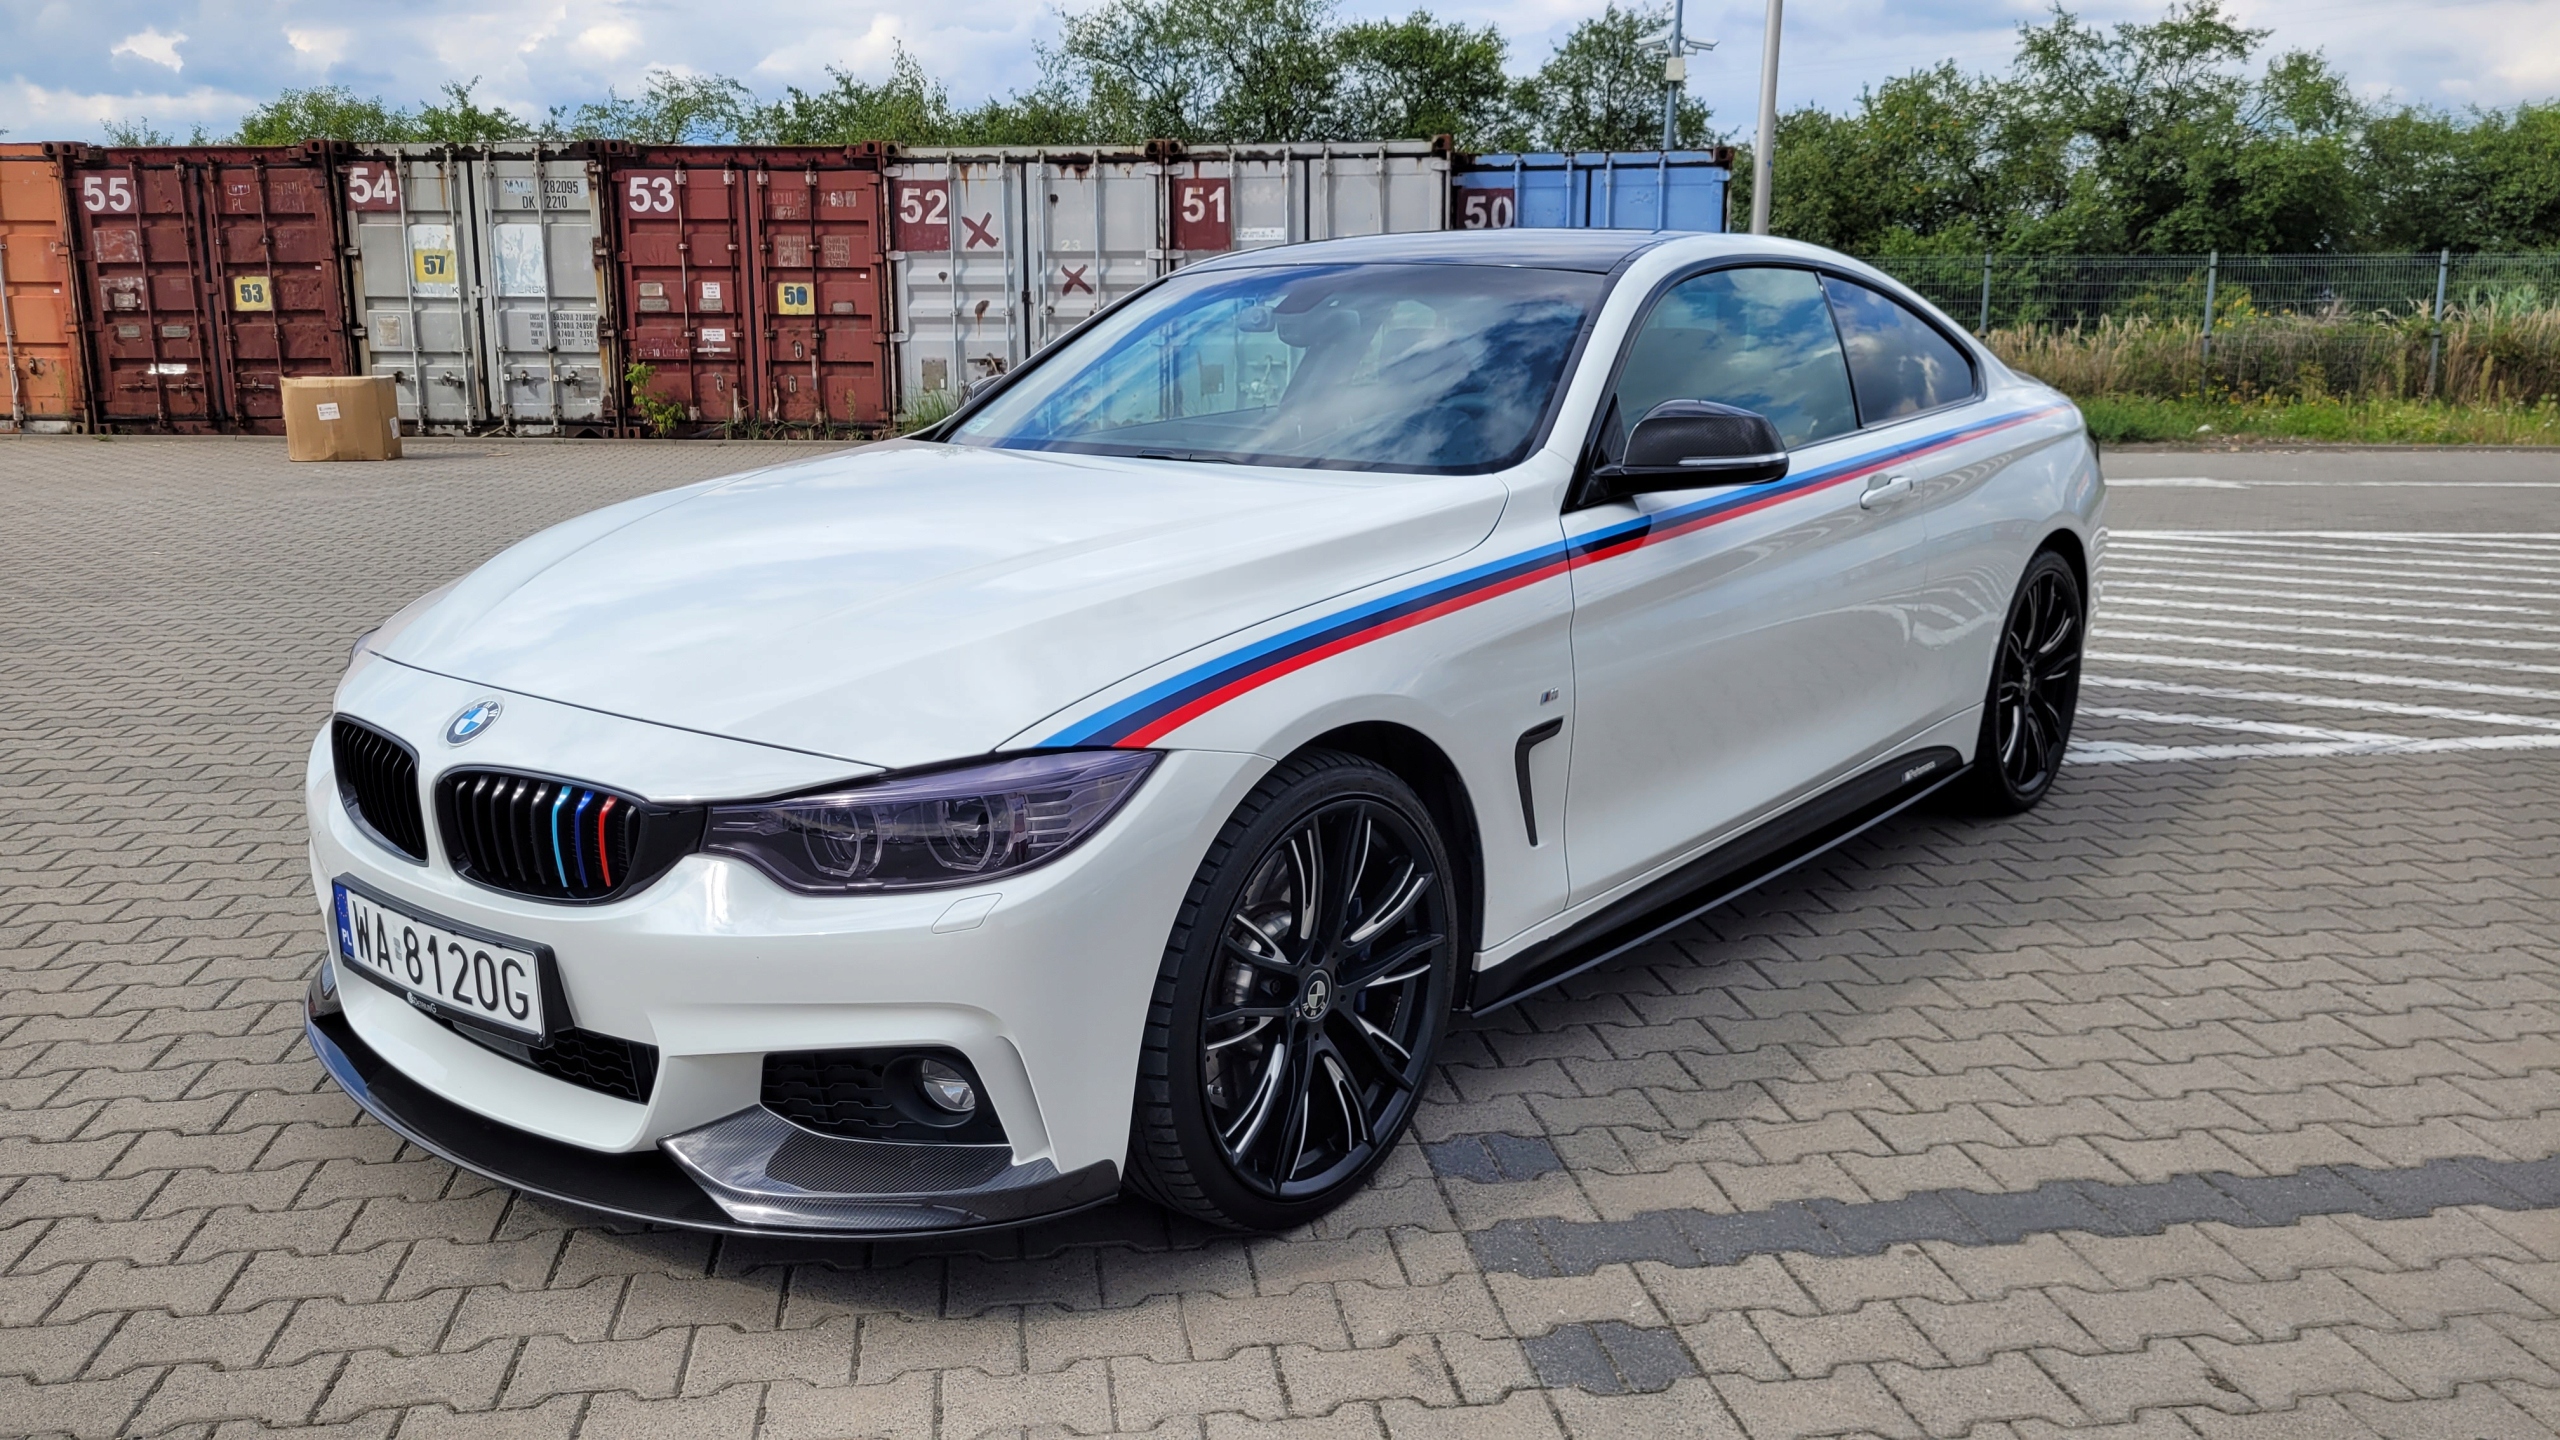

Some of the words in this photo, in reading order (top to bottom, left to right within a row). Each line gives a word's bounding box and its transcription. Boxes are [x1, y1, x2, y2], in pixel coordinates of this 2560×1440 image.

[84, 176, 132, 212] 55
[350, 167, 397, 205] 54
[522, 196, 536, 209] DK
[546, 196, 568, 209] 2210
[543, 180, 579, 194] 282095
[629, 176, 675, 213] 53
[900, 187, 948, 225] 52
[1182, 186, 1226, 223] 51
[1464, 195, 1514, 229] 50
[423, 255, 446, 275] 57
[240, 283, 264, 303] 53
[341, 927, 353, 947] PL
[352, 900, 394, 975] WA
[403, 925, 530, 1021] 8120G
